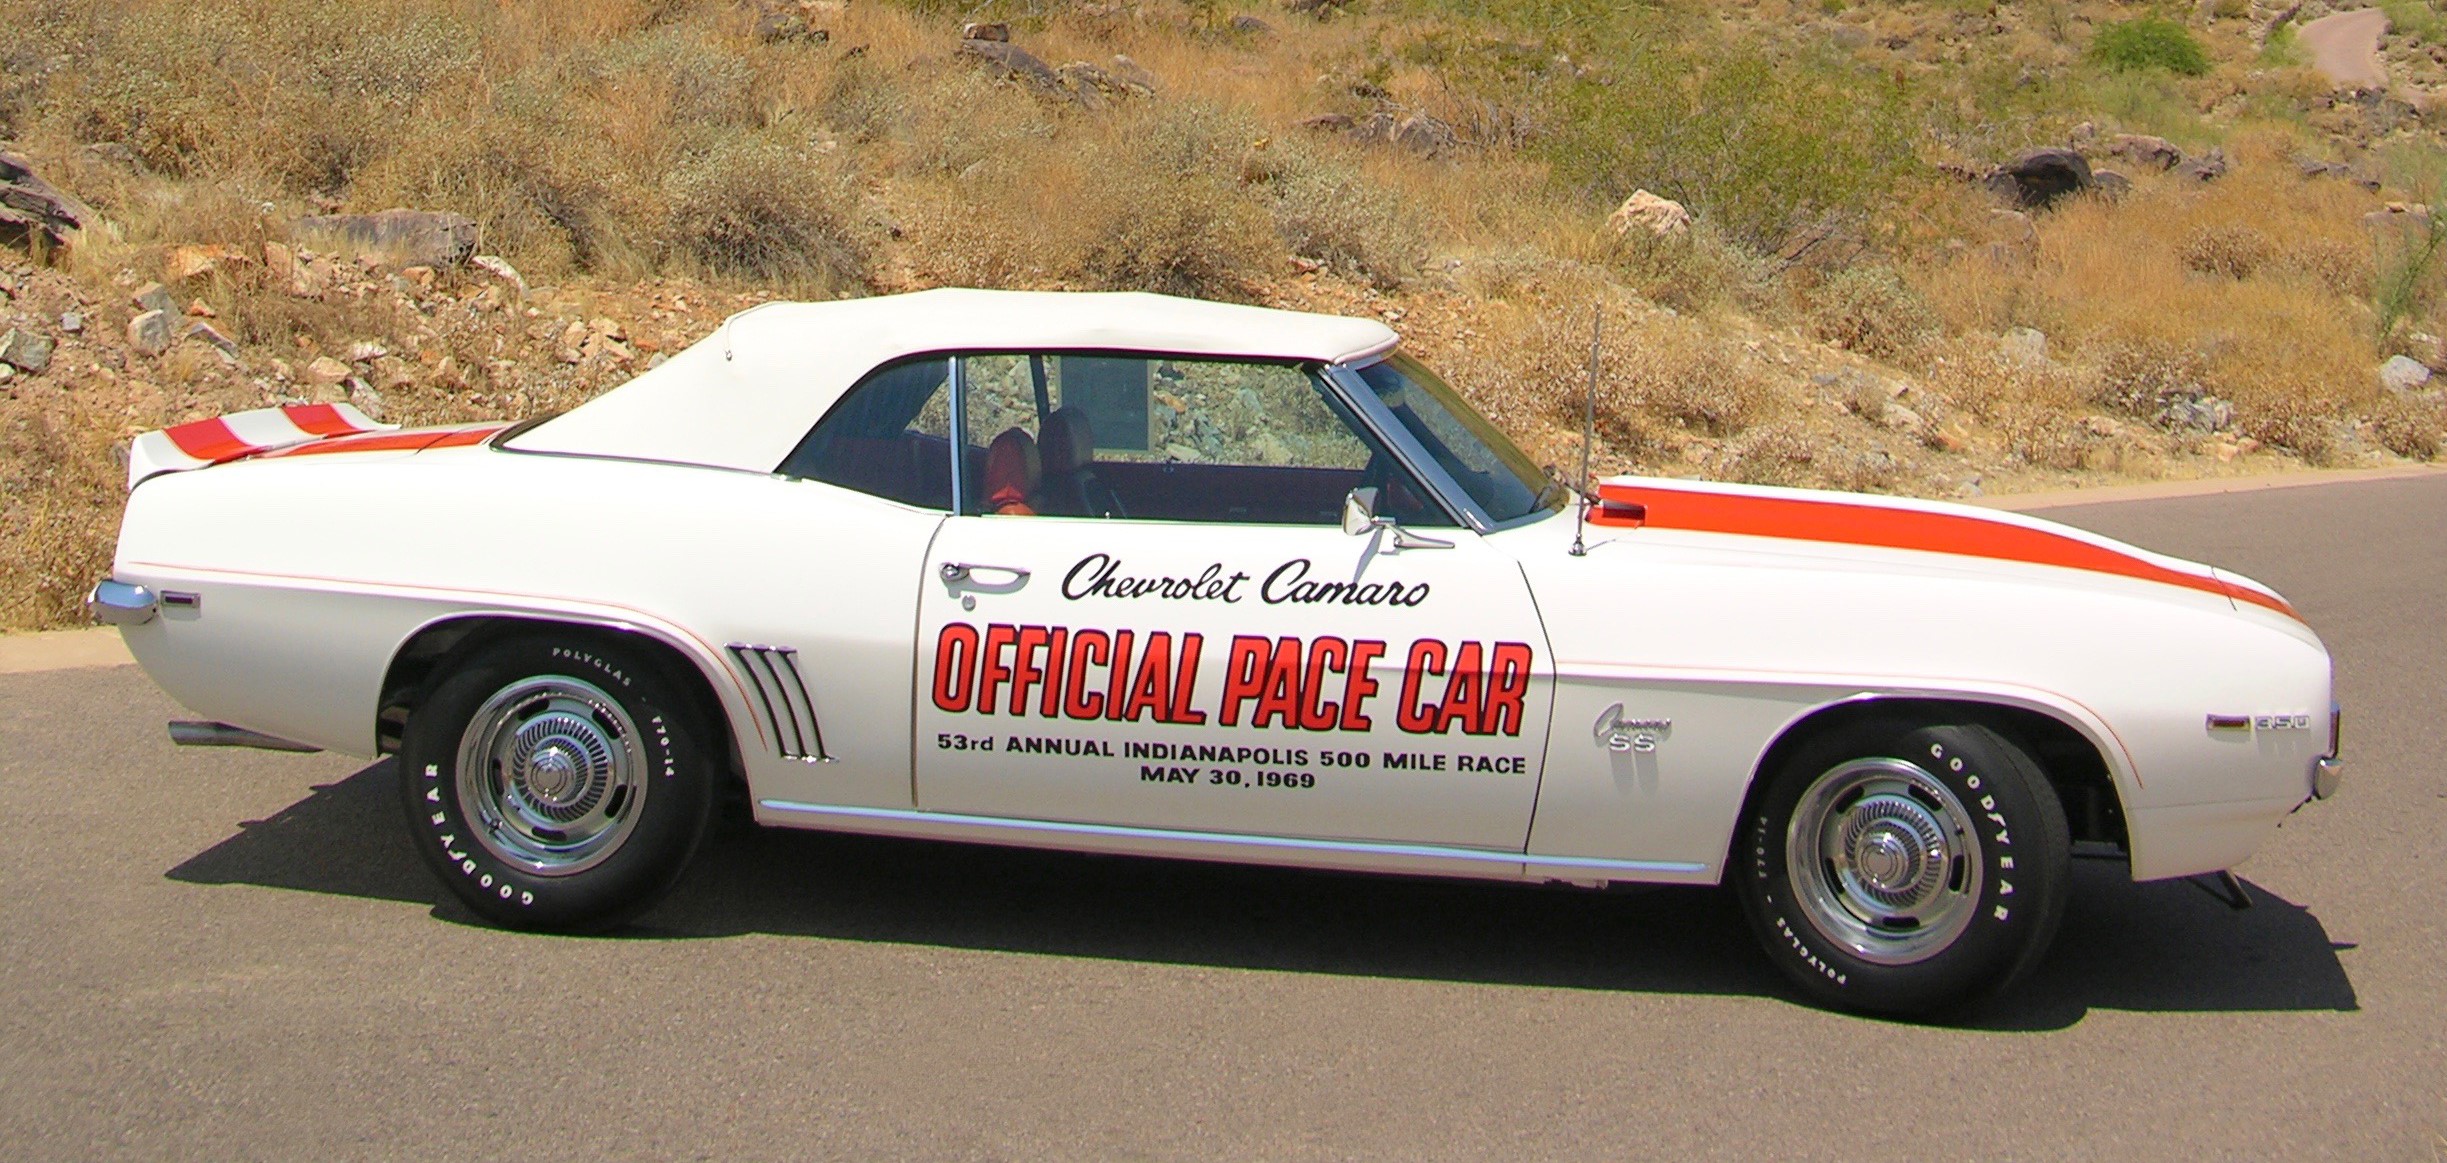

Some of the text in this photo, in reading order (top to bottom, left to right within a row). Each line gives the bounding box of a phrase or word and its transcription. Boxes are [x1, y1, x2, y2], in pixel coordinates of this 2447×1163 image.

[1061, 553, 1430, 607] Chevrolet Camaro
[552, 646, 632, 687] POLYGLAS
[931, 622, 1533, 736] OFFICIAL PACE CAR
[1609, 733, 1655, 752] SS
[2255, 714, 2310, 730] 350
[937, 733, 1526, 774] 53rd ANNUAL INDIANAPOLIS 500 MILE RACE
[1140, 765, 1200, 784] MAY
[424, 763, 534, 906] GOODYEAR
[1930, 743, 2014, 921] GOODYEAR
[1776, 917, 1847, 985] POLYGLAS
